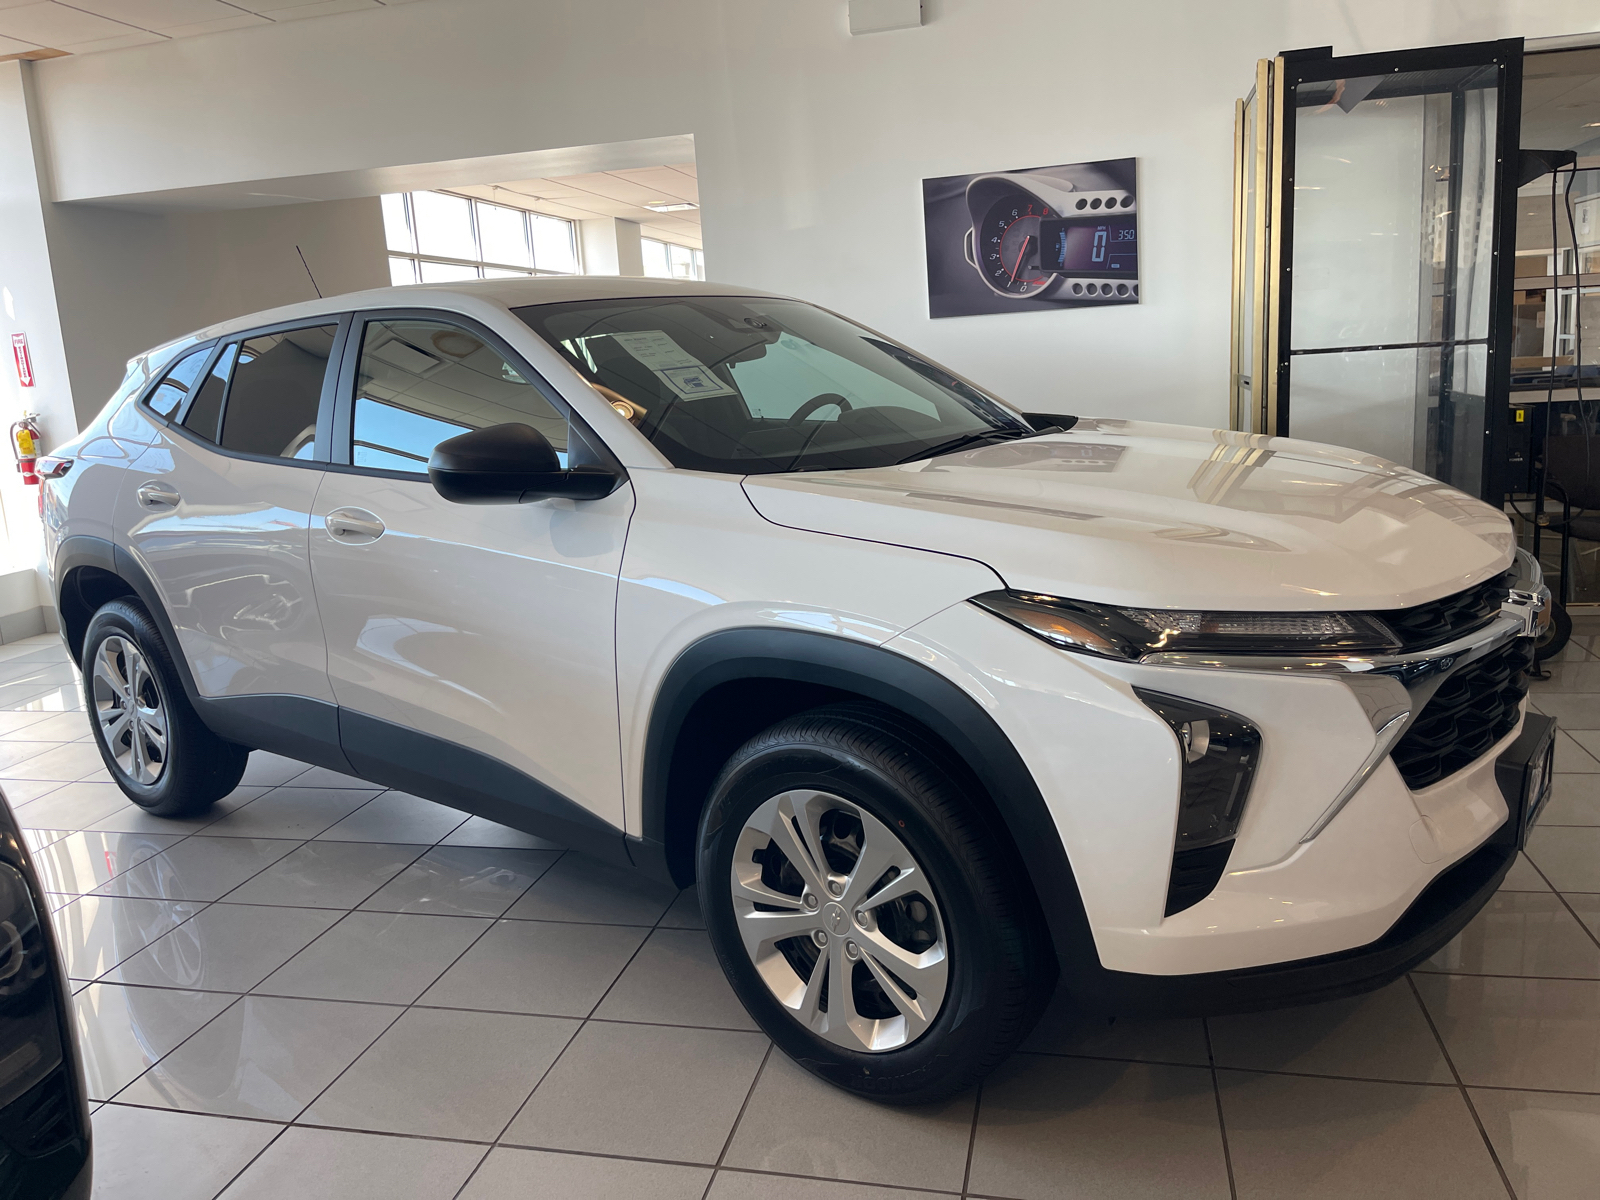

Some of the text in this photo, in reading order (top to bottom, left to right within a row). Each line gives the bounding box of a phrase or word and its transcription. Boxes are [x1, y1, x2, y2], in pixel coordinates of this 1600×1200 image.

[1027, 204, 1033, 212] 7
[1042, 207, 1049, 215] 8
[1118, 229, 1135, 240] 350
[1091, 231, 1107, 262] 0
